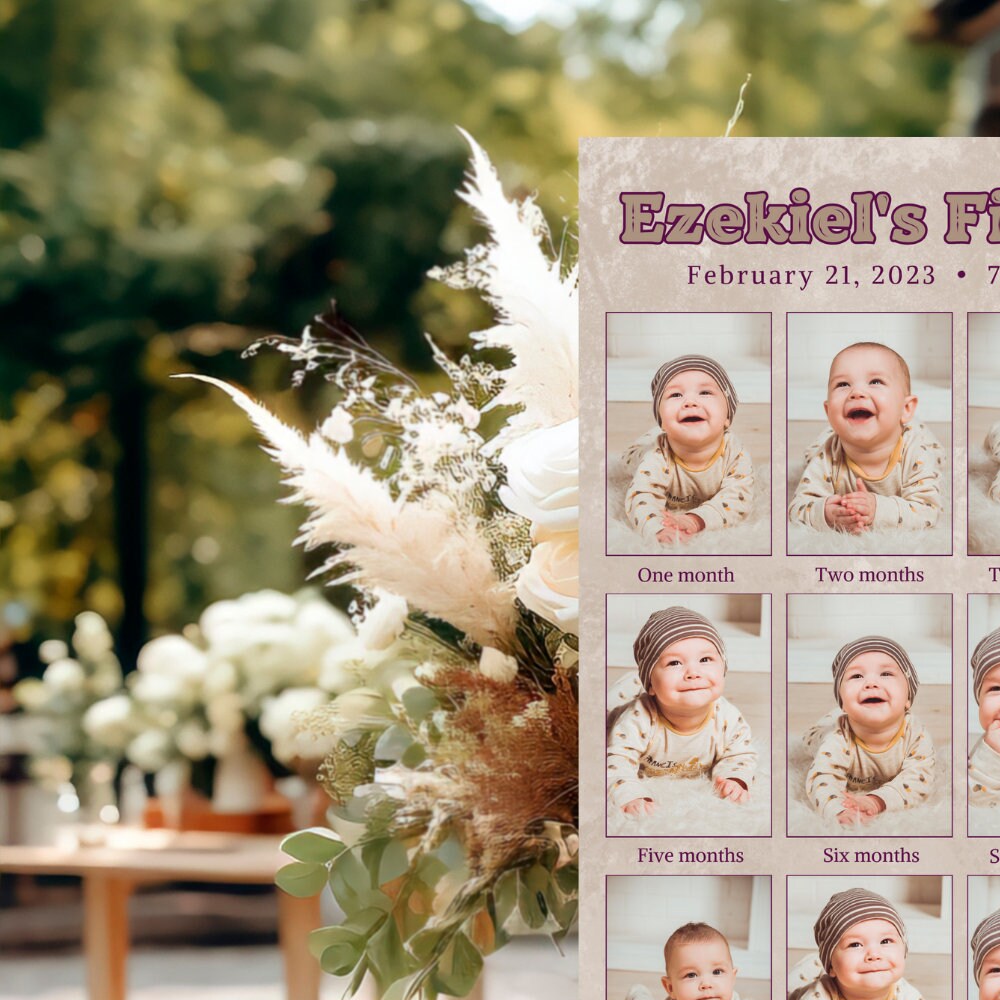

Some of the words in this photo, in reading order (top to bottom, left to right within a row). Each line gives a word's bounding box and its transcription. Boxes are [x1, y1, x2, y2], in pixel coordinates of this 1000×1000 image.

[619, 187, 929, 245] Ezekiel's
[687, 264, 814, 291] February
[825, 265, 860, 289] 21,
[871, 265, 936, 285] 2023
[637, 567, 674, 583] One
[677, 566, 735, 583] month
[815, 567, 855, 583] Two
[858, 566, 925, 583] months
[637, 847, 674, 863] Five
[678, 847, 745, 863] months
[823, 847, 850, 863] Six
[854, 847, 920, 863] months
